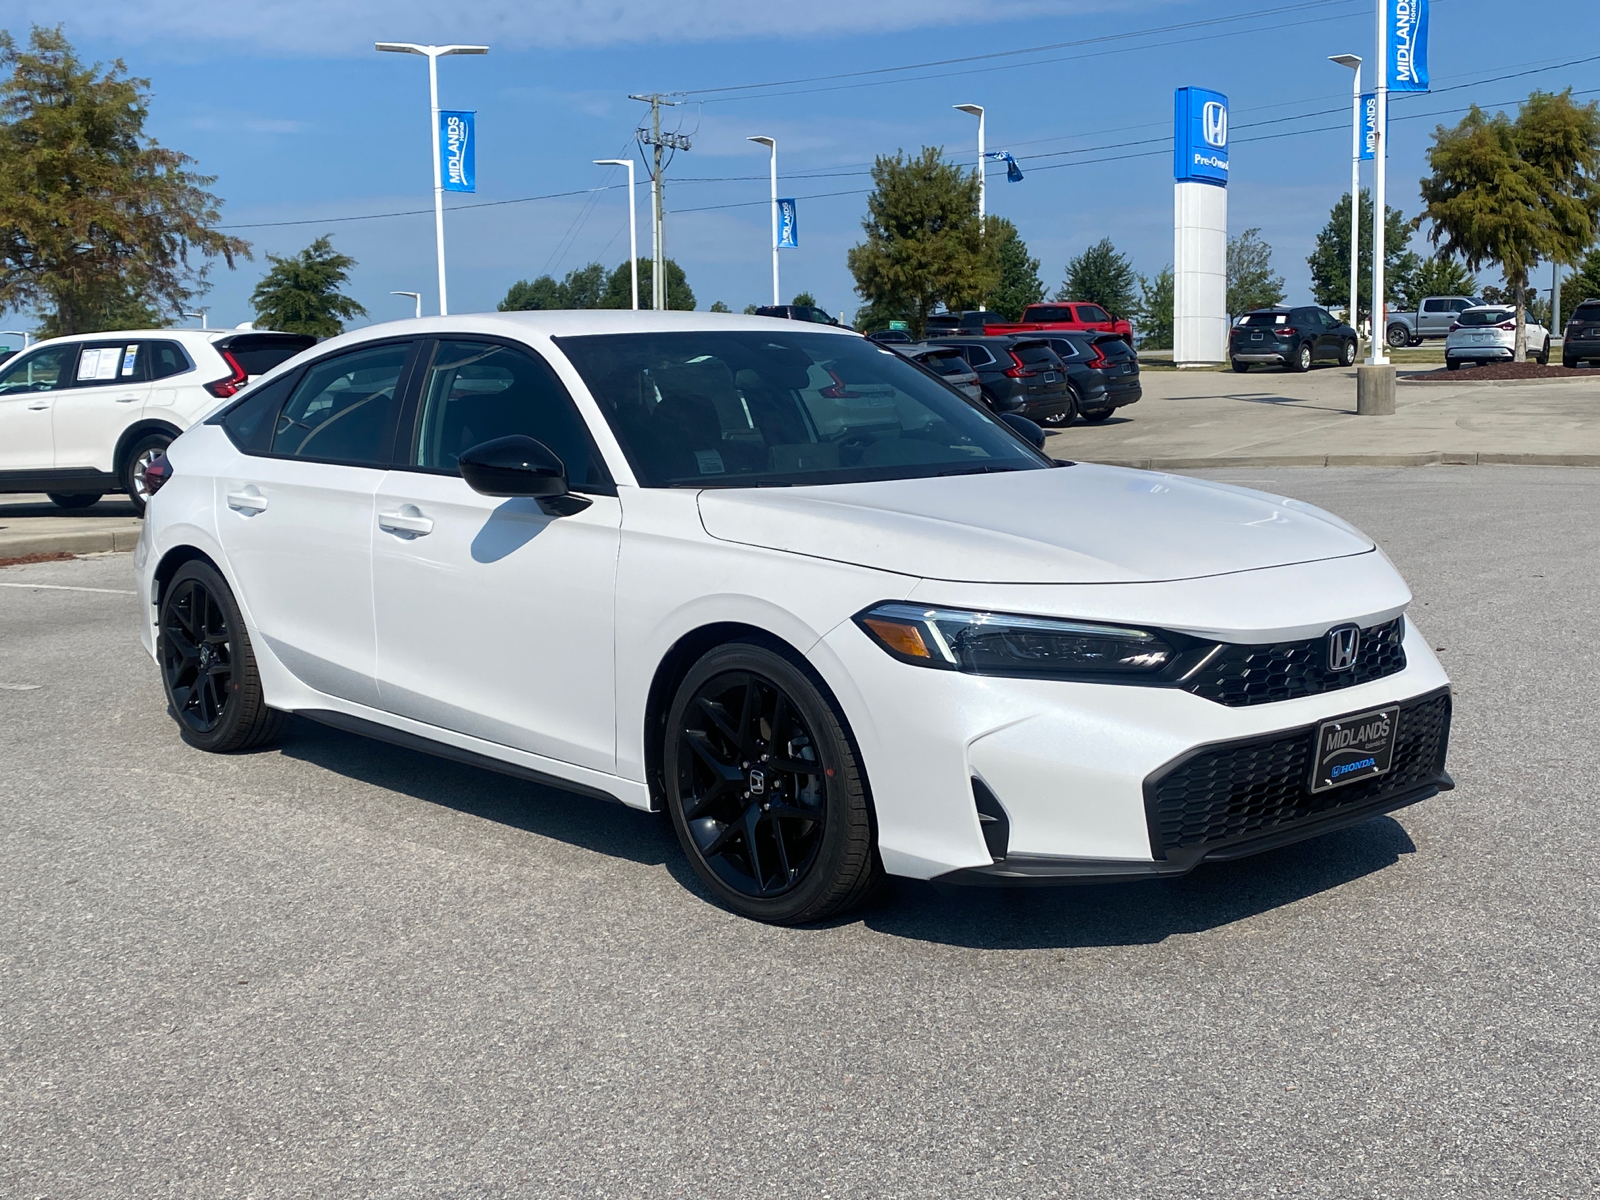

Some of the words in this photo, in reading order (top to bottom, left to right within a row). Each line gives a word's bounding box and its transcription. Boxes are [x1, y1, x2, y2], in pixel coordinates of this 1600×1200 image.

[1396, 0, 1410, 81] MIDLAND
[447, 116, 460, 184] MIDLANDS
[1366, 98, 1376, 153] MIDLANDS
[1326, 718, 1391, 751] MIDLANDS
[1340, 757, 1376, 774] HONDA
